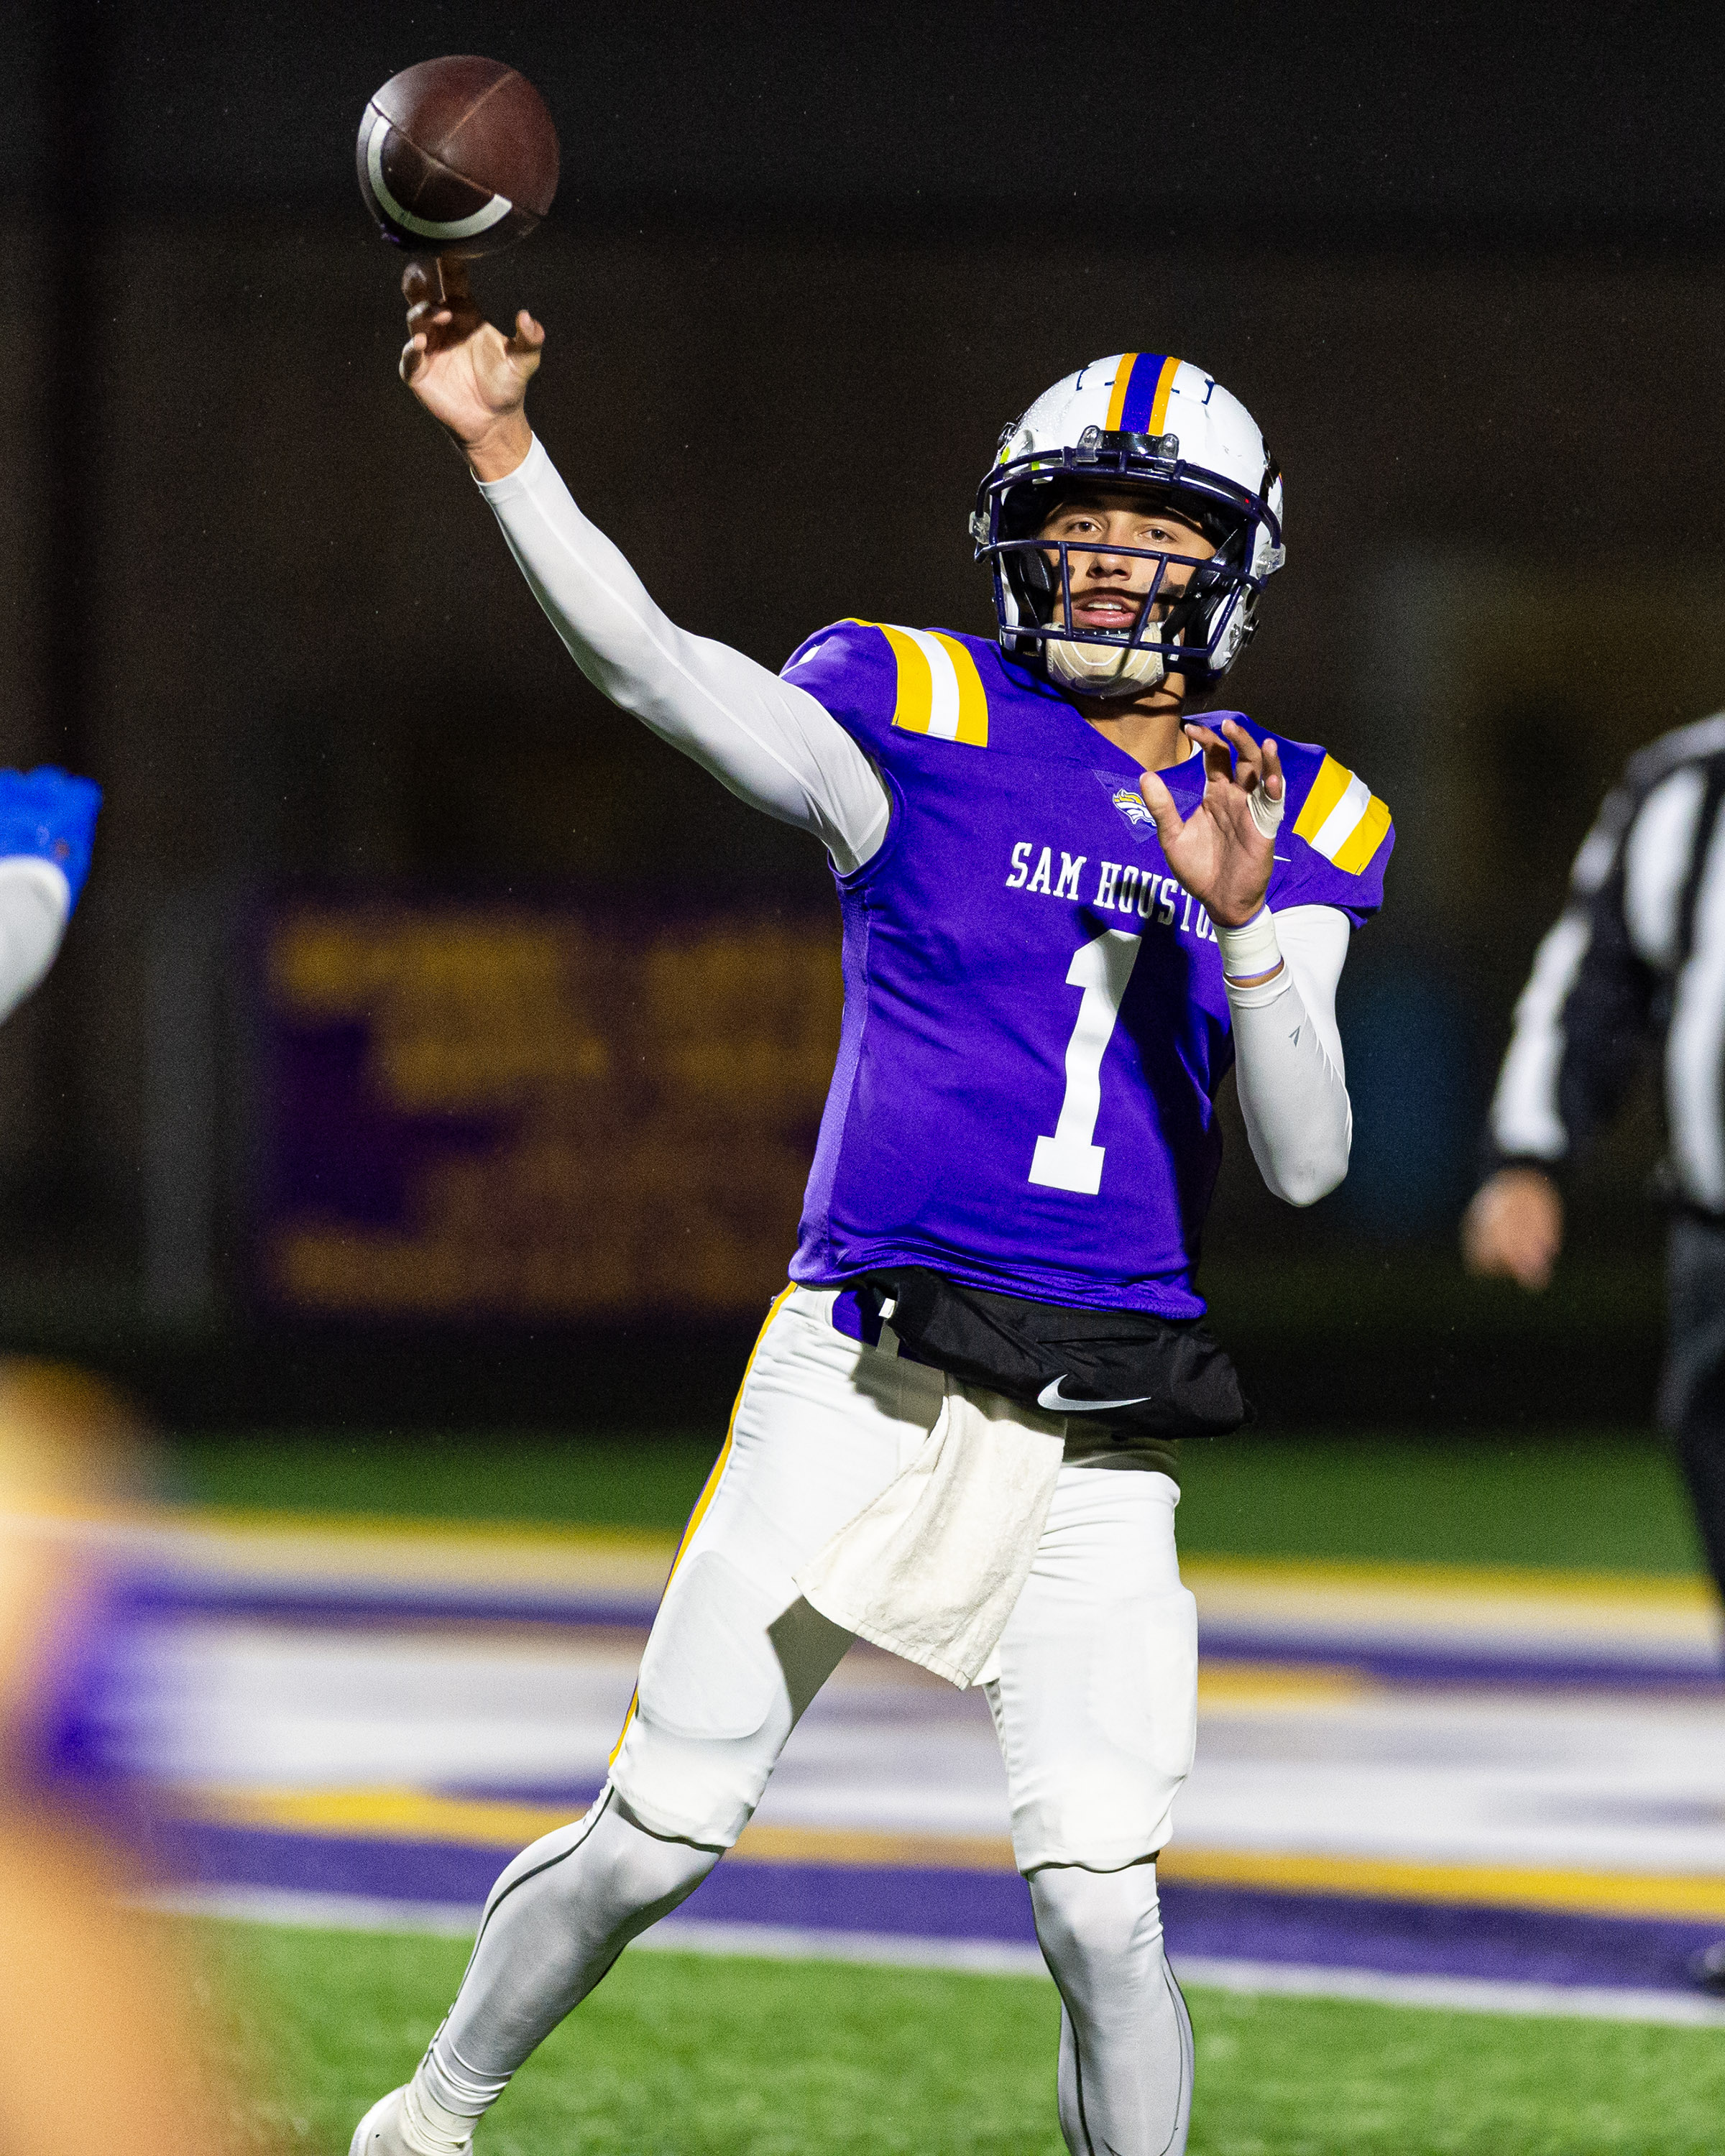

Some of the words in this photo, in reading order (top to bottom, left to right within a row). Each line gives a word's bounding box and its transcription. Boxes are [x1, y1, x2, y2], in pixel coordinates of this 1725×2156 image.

[1006, 842, 1087, 900] SAM
[1092, 861, 1218, 943] HOUSTO
[1028, 929, 1141, 1195] 1
